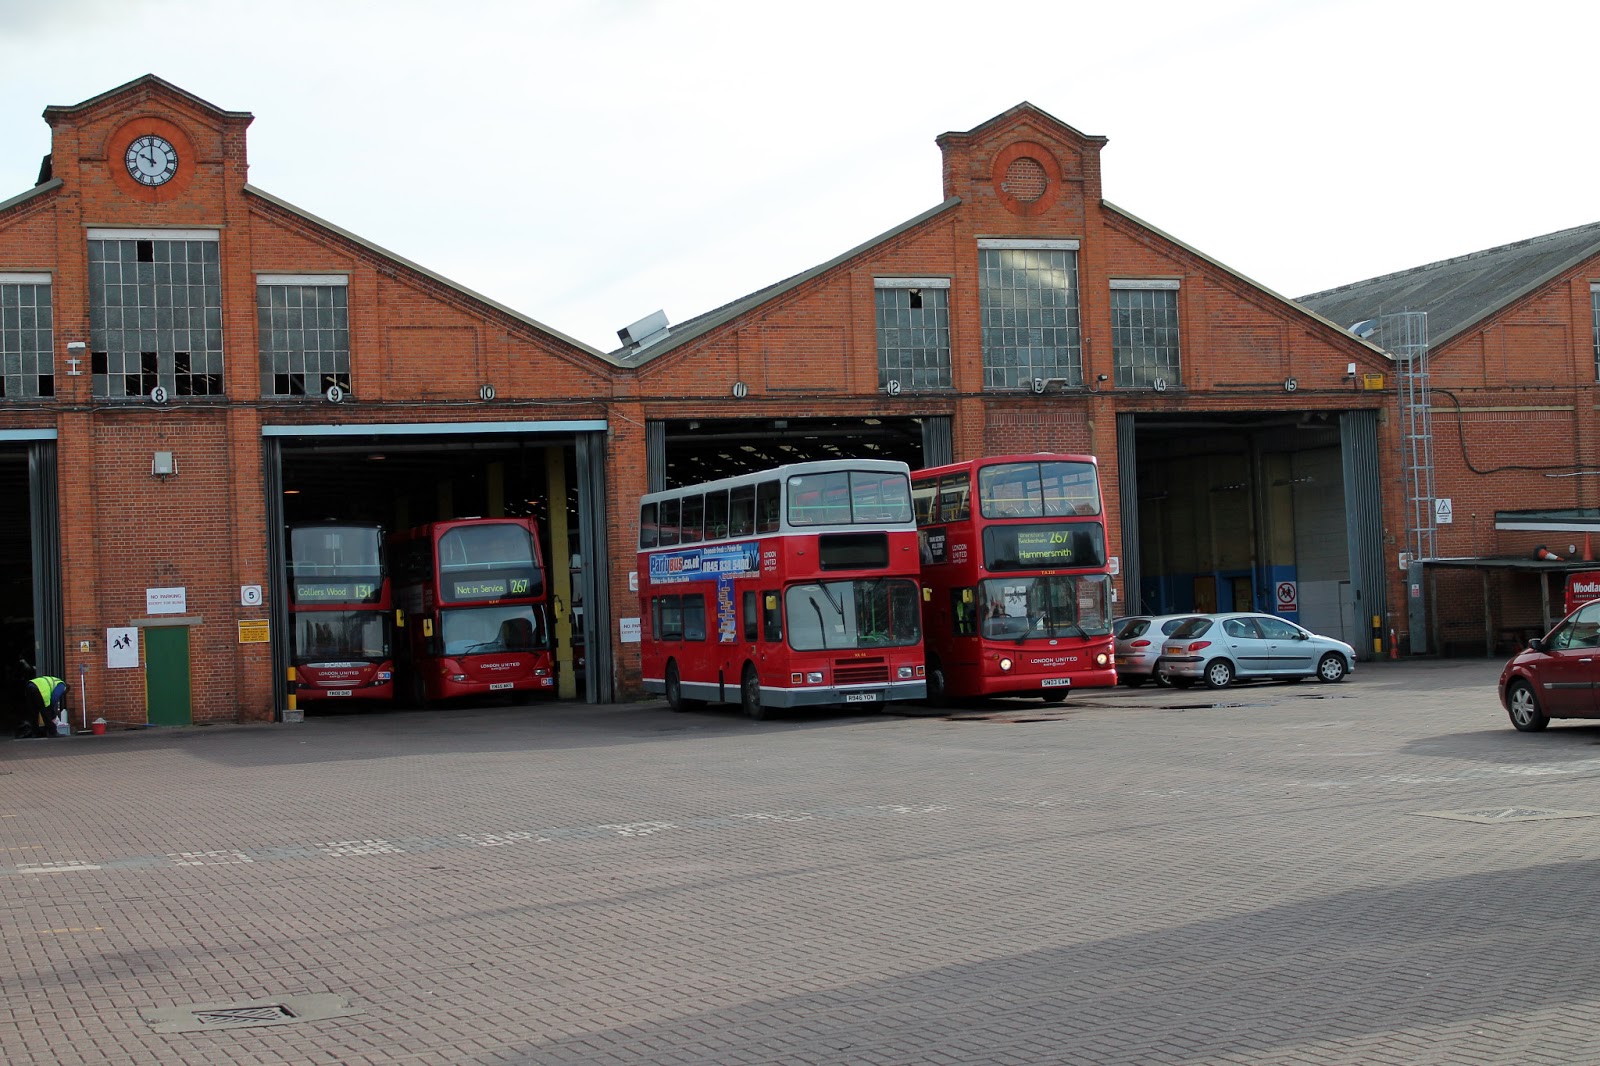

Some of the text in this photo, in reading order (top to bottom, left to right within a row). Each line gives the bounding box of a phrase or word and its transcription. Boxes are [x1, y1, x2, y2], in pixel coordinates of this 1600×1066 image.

[736, 383, 744, 397] 11
[889, 382, 899, 394] 12
[1155, 378, 1164, 390] 14
[1287, 378, 1296, 390] 15
[155, 388, 163, 401] 8
[331, 388, 339, 401] 9
[482, 386, 493, 399] 10
[1049, 531, 1069, 543] 267
[1019, 548, 1072, 559] Hammersmith
[298, 588, 347, 596] Colliers Wood
[355, 585, 371, 598] 131
[457, 586, 471, 594] Not
[481, 585, 504, 593] Service
[511, 580, 528, 593] 267
[248, 591, 255, 600] 5
